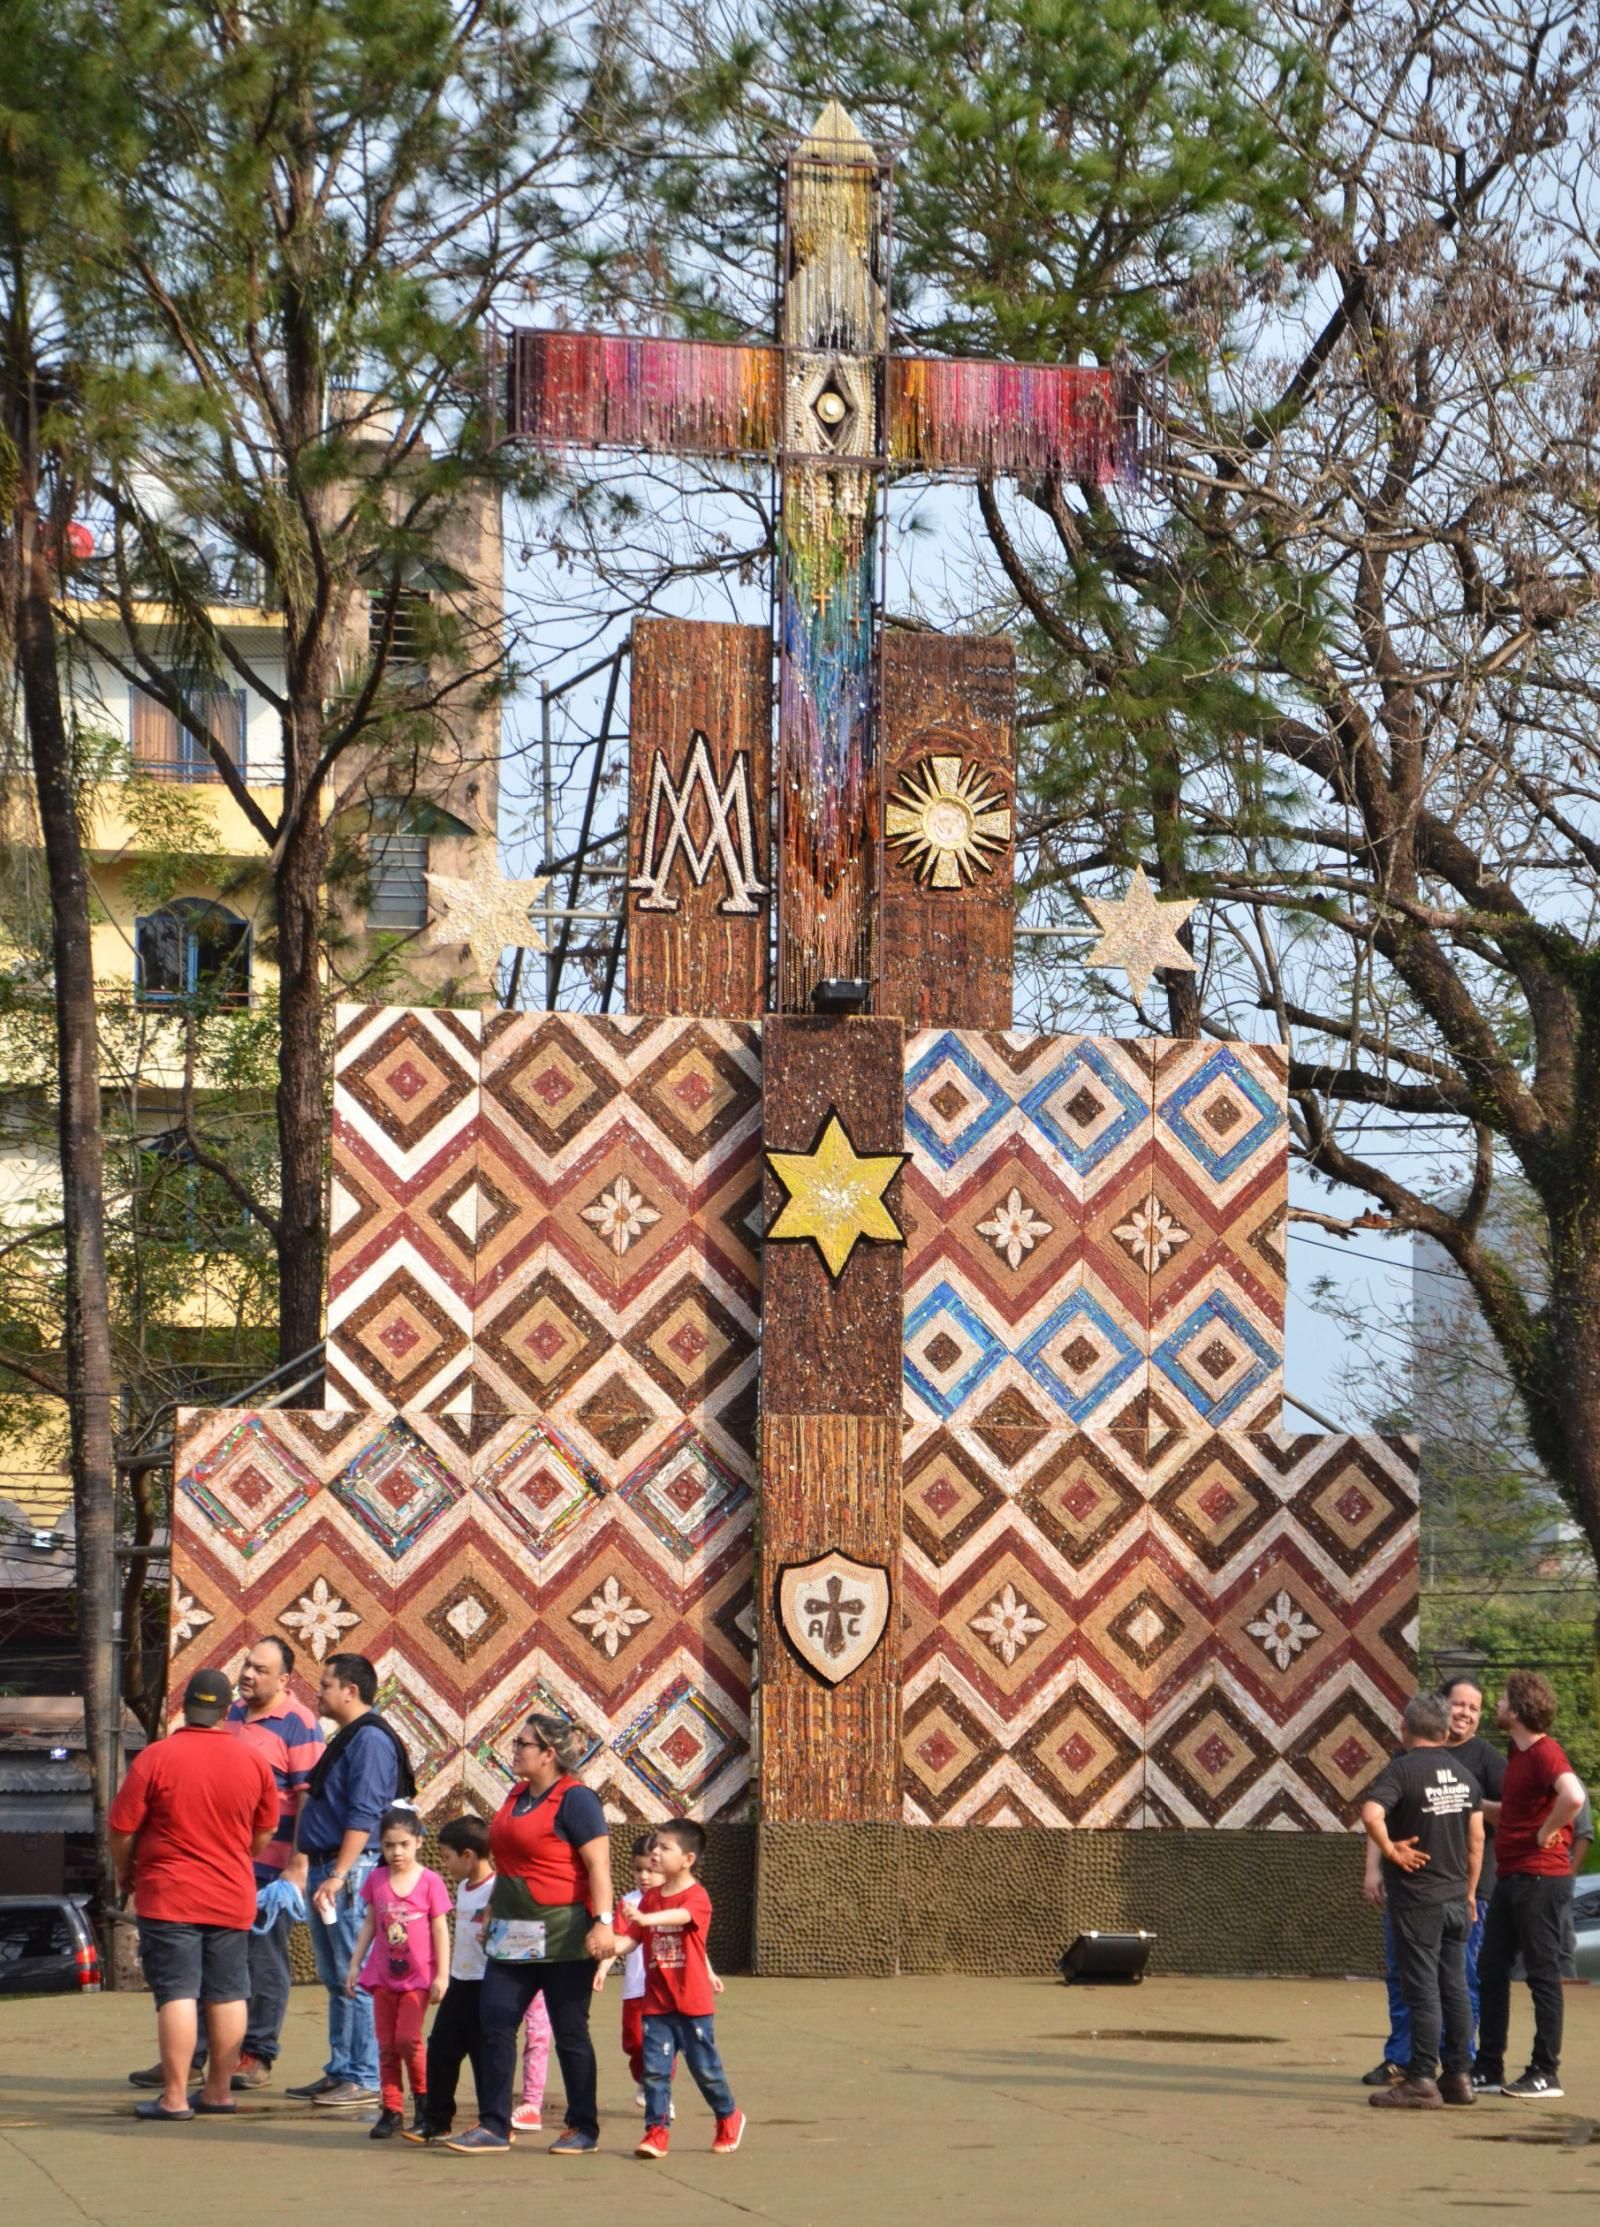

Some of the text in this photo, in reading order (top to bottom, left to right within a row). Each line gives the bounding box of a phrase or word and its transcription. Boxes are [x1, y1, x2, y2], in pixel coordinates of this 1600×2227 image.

[808, 1617, 861, 1639] A C
[1436, 1769, 1458, 1784] NL
